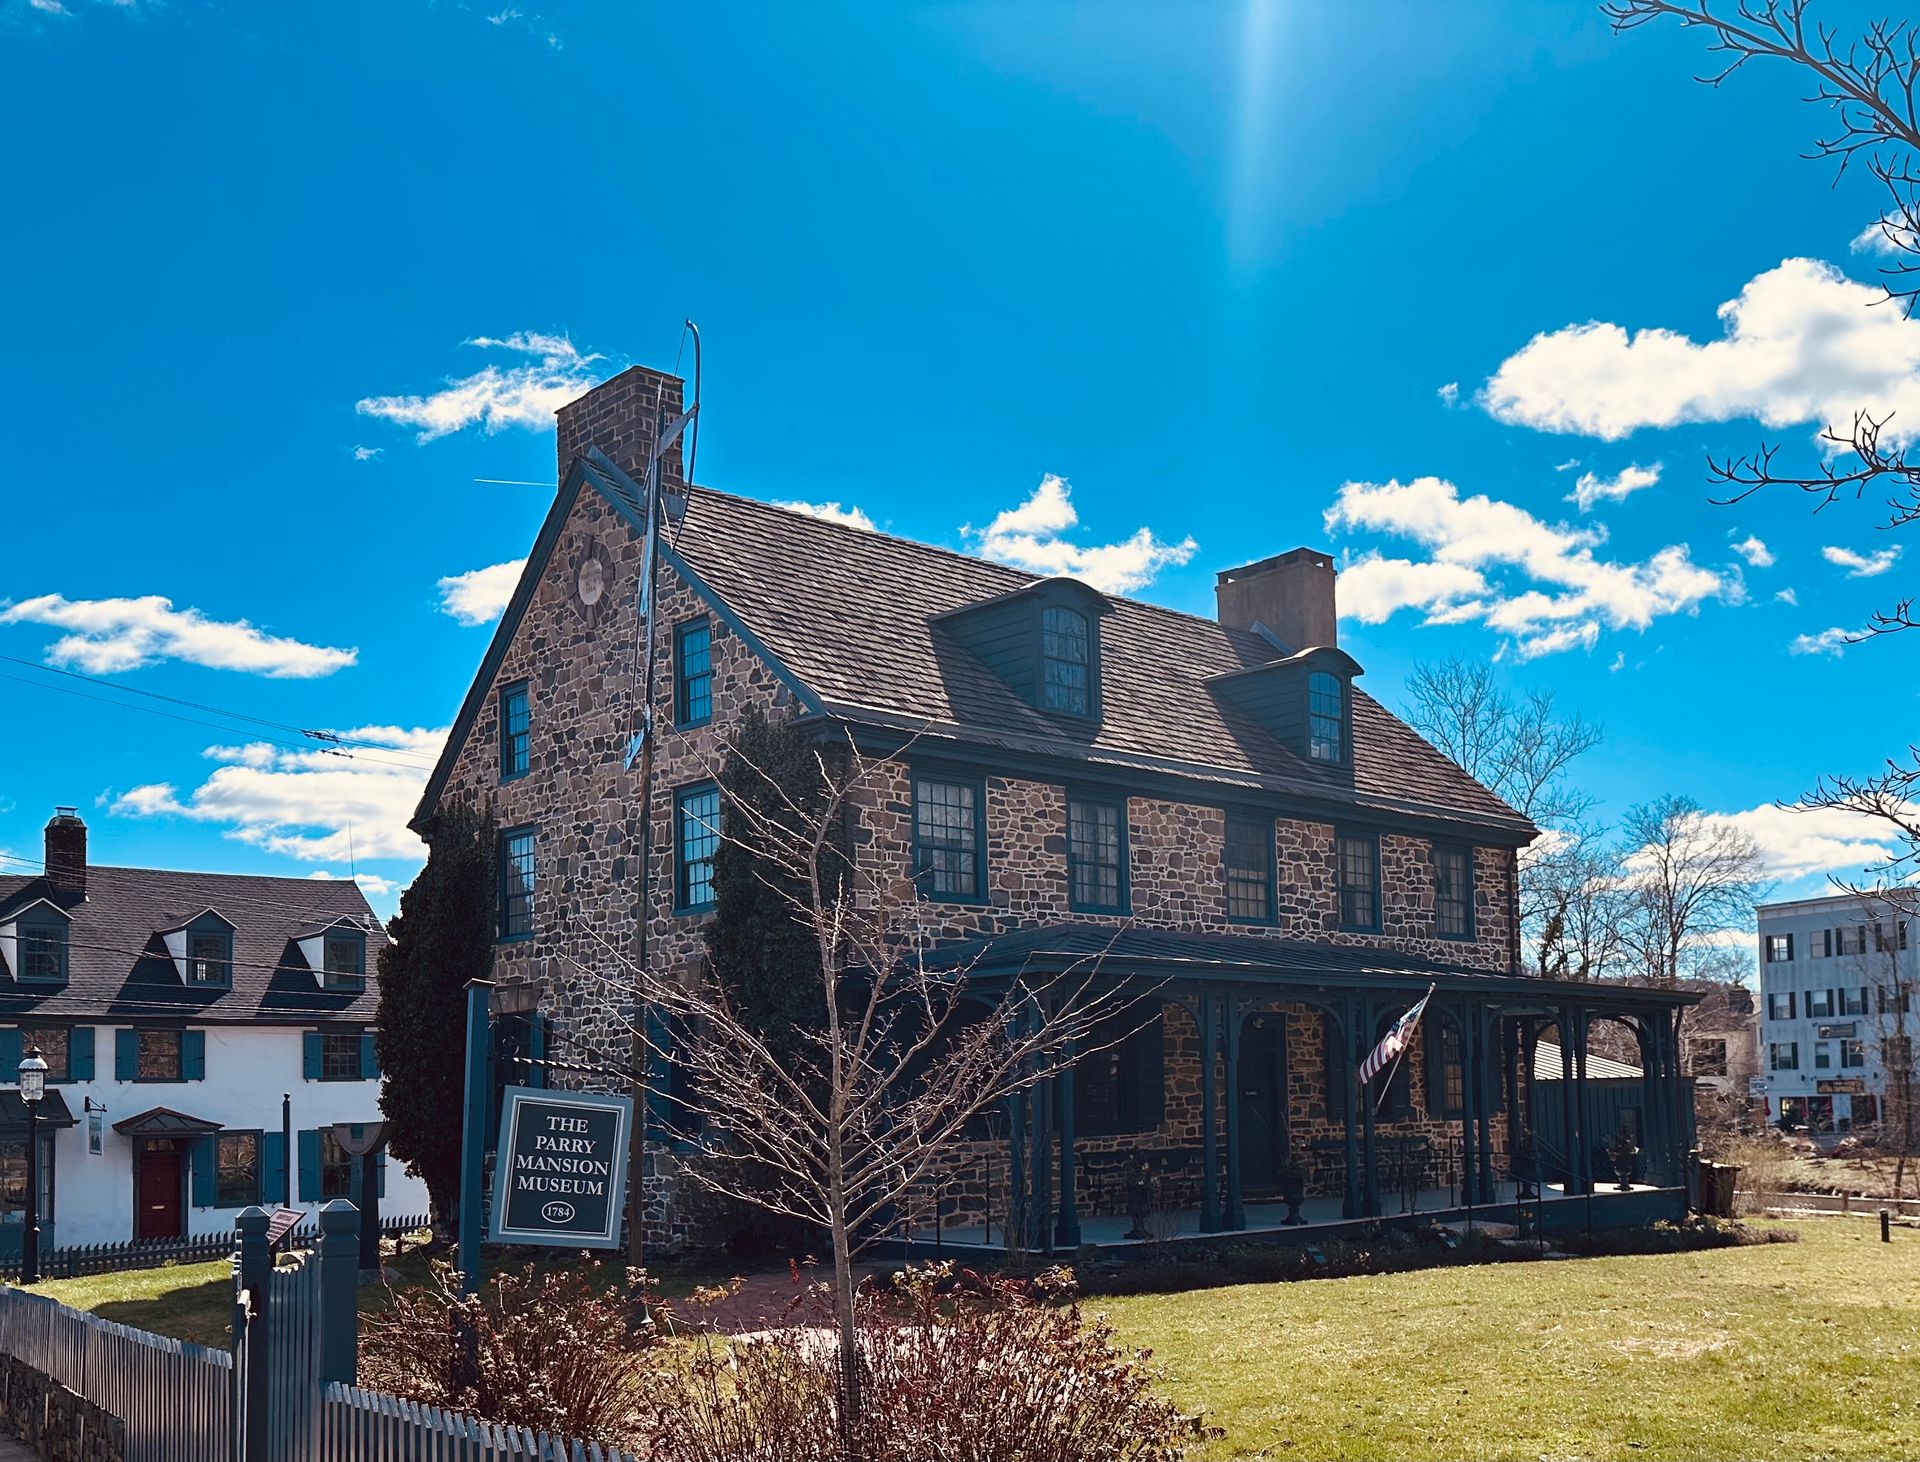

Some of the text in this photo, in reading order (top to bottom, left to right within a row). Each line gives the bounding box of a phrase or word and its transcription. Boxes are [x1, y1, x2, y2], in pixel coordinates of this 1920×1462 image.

[547, 1116, 589, 1133] THE
[535, 1136, 597, 1154] PARRY
[517, 1154, 609, 1175] MANSION
[518, 1176, 603, 1195] MUSEUM
[547, 1206, 570, 1217] 1784
